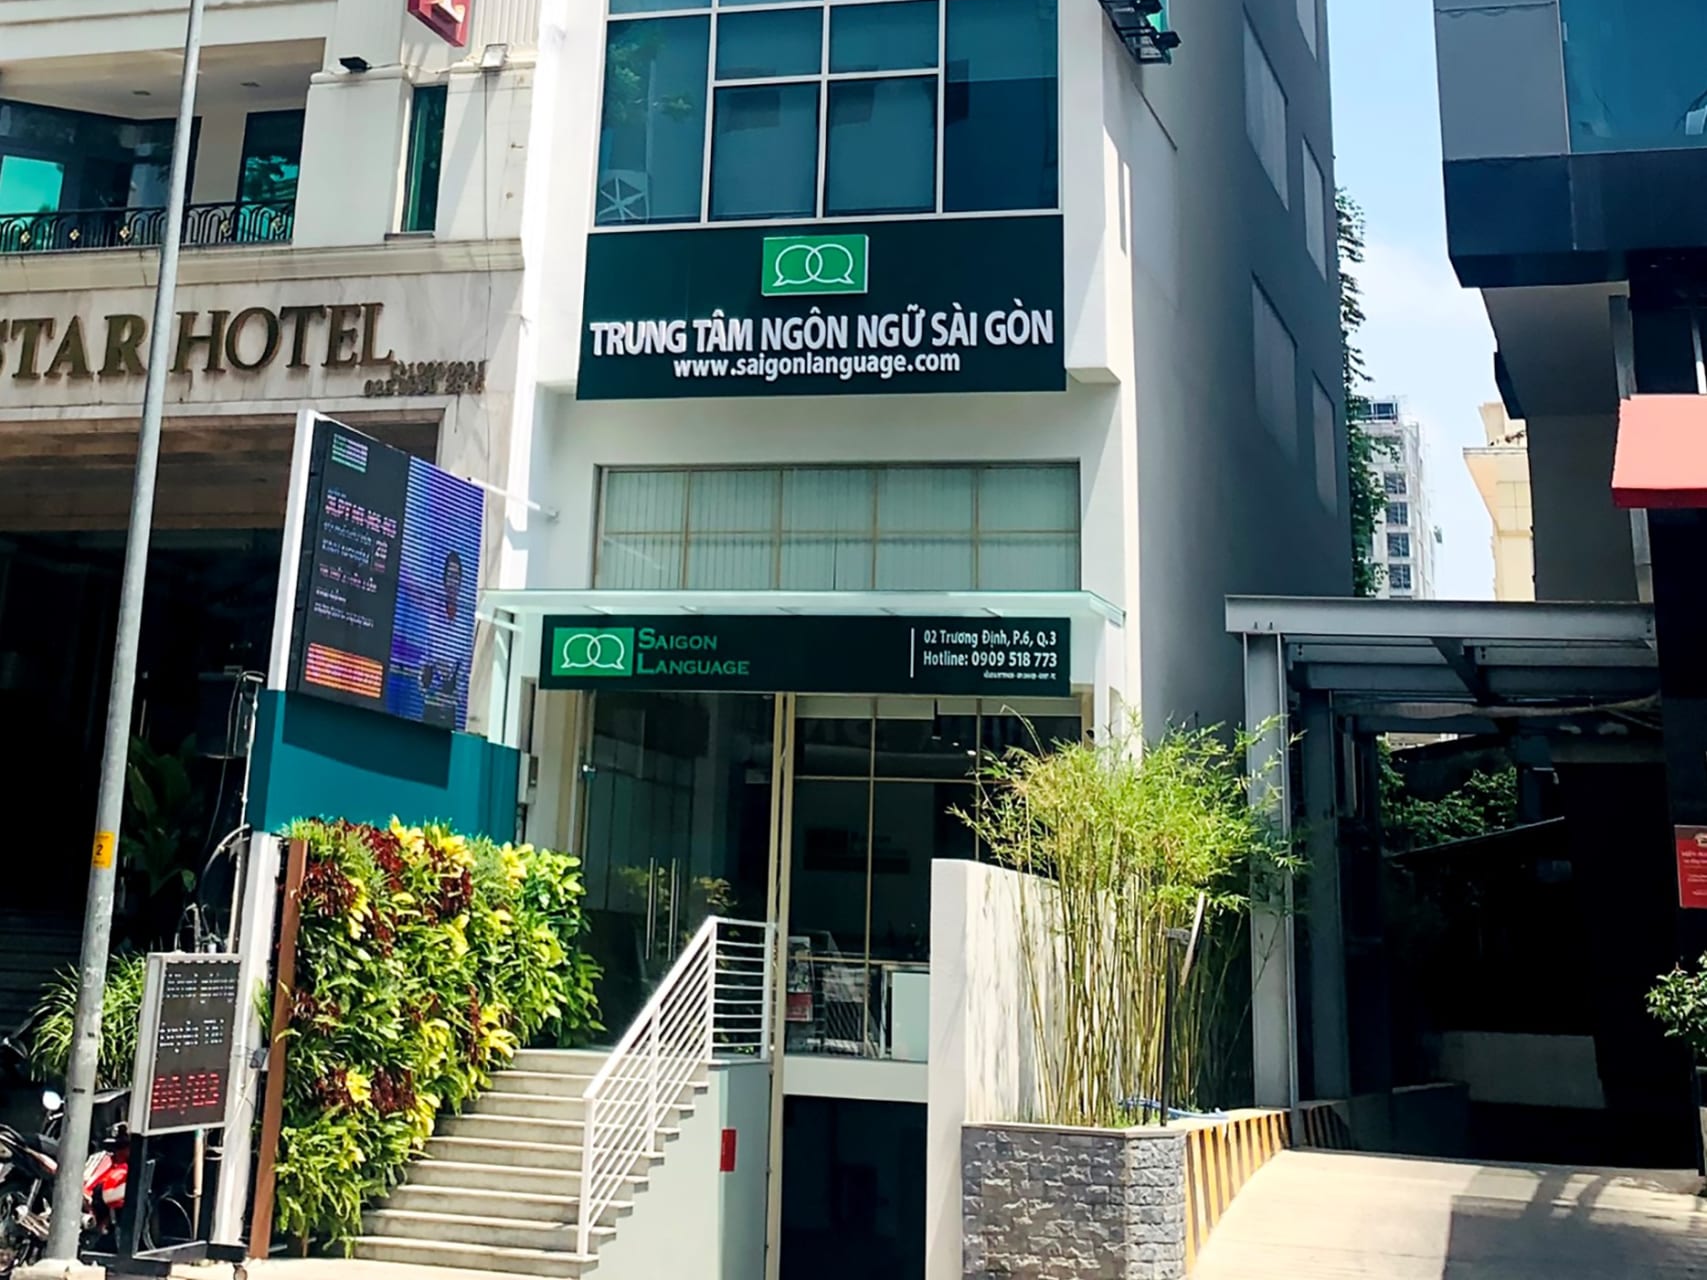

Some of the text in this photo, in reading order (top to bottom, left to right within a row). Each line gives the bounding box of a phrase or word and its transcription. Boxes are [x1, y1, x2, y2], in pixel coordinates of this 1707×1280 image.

[589, 297, 1054, 356] TRUNG TÂM NGÔN NGỮ SÀI GÒN
[0, 301, 394, 380] TAR HOTEL
[673, 351, 961, 382] www.saigonlanguage.com
[637, 627, 718, 650] SAIGON
[923, 629, 937, 644] 02
[1012, 630, 1034, 648] P.6,
[636, 652, 750, 675] LANGUAGE
[923, 650, 1058, 668] Hotline: 0909 518 773
